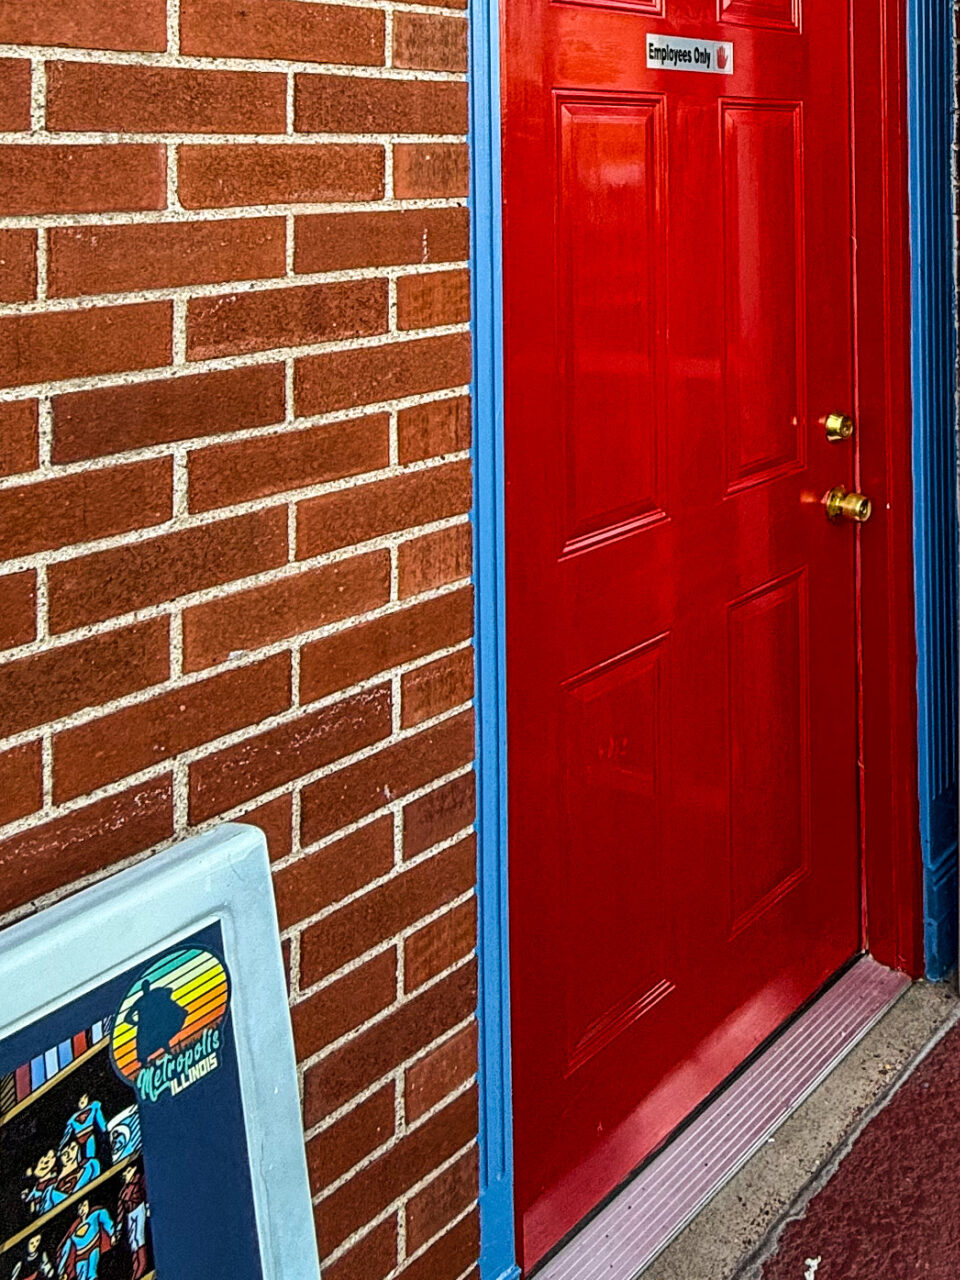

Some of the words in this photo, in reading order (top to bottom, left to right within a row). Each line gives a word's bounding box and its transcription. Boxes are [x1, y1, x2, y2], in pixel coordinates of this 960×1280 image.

[648, 42, 692, 67] Employees
[693, 46, 711, 69] Only
[137, 1028, 220, 1102] Metropolis
[170, 1052, 218, 1096] ILLINOIS
